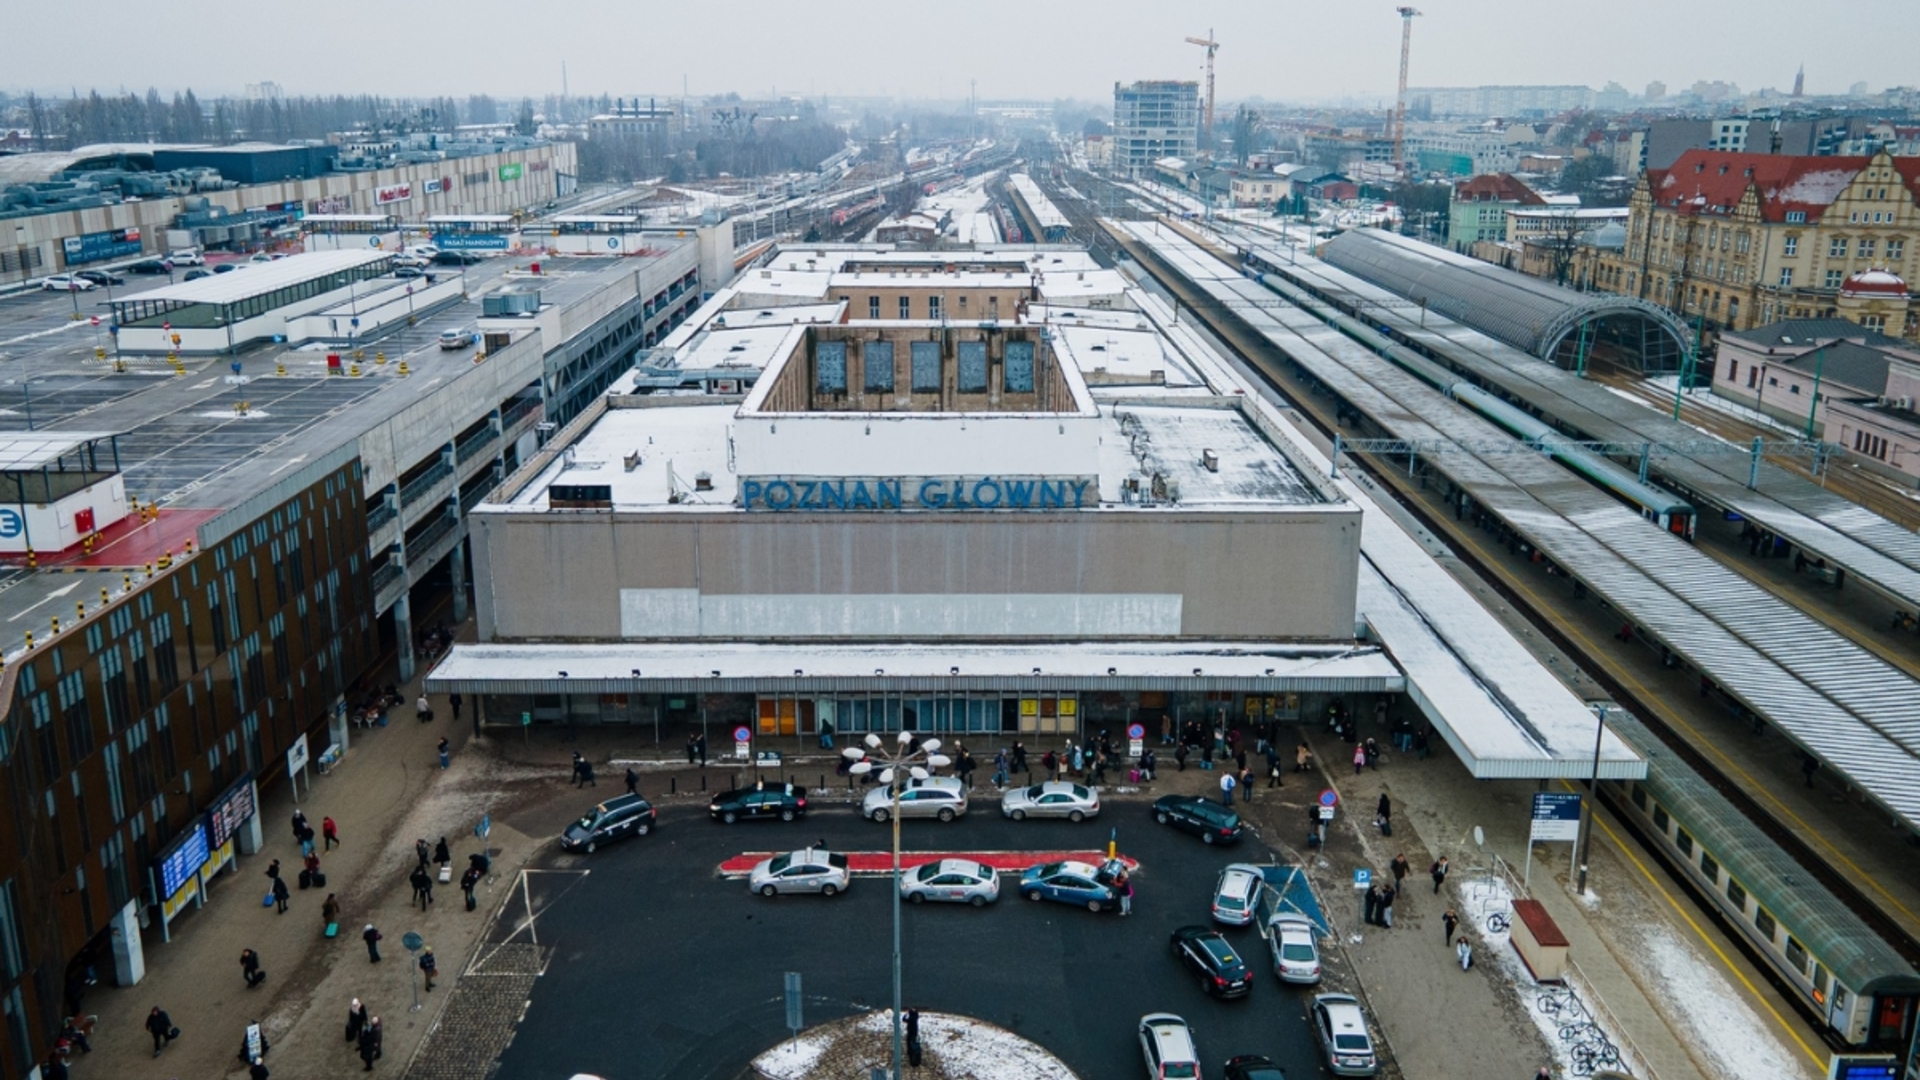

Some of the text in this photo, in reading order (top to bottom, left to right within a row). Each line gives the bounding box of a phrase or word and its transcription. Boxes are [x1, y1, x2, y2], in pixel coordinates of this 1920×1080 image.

[465, 239, 504, 247] HANDLOWY
[743, 476, 1090, 510] POZNAŃ GŁÓWNY
[1358, 870, 1367, 881] P
